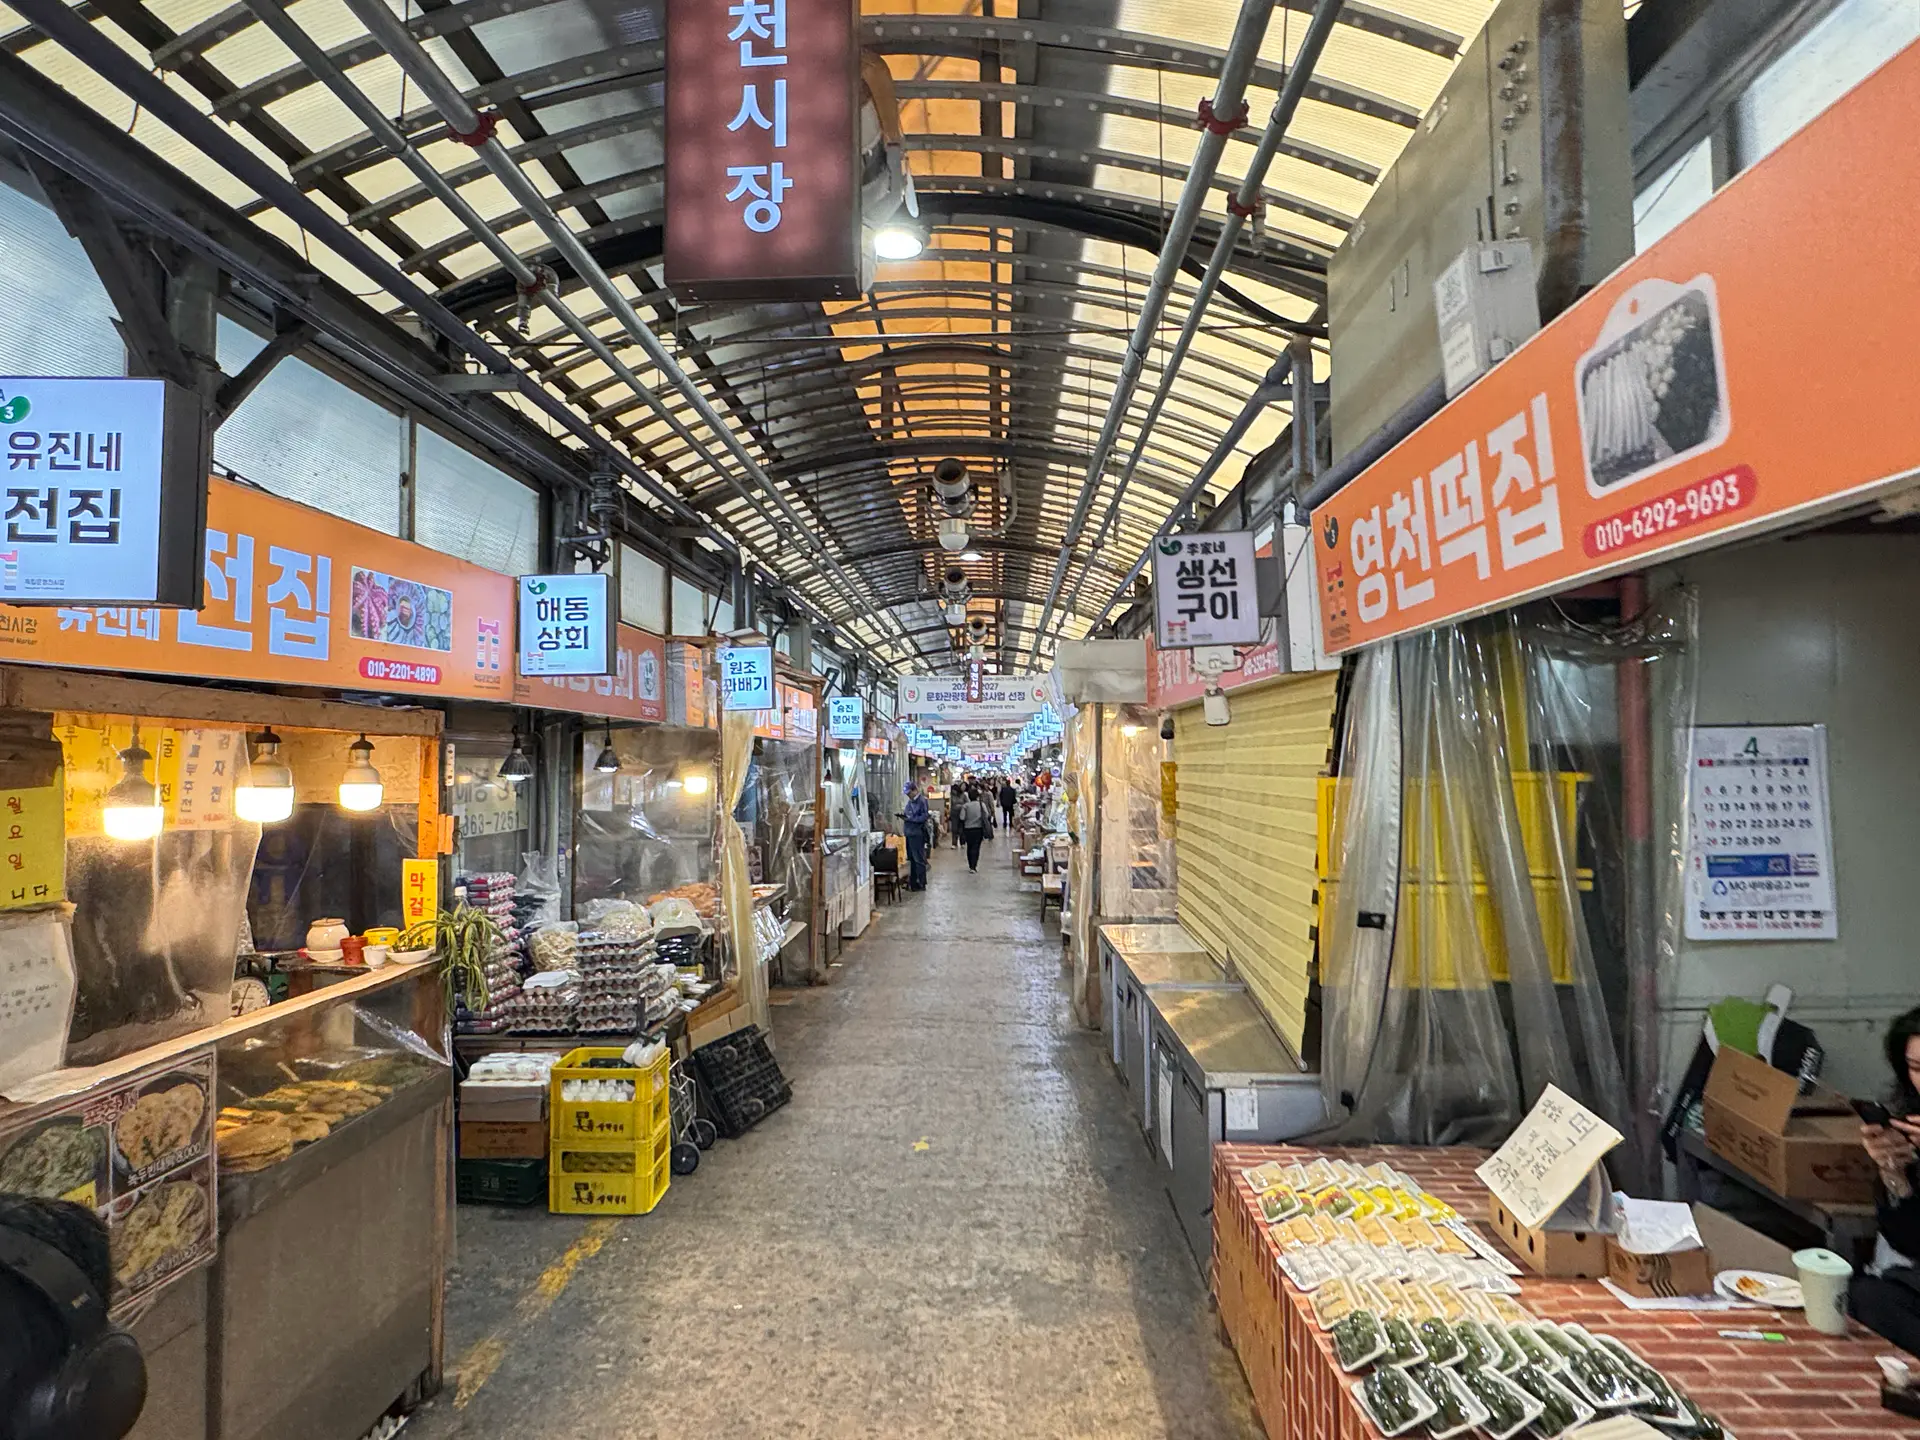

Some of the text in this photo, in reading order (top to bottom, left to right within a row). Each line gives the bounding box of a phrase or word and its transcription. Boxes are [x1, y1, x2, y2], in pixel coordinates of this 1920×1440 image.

[726, 0, 794, 233] 천시장
[4, 406, 15, 420] 3
[7, 431, 122, 472] 유진네
[4, 486, 121, 545] 전집
[1350, 391, 1563, 623] 영천떡집
[1594, 473, 1741, 553] 010-6292-9693
[1176, 557, 1238, 590] 생선
[536, 597, 589, 622] 해동
[1177, 590, 1239, 622] 구이
[537, 626, 589, 651] 상회
[367, 660, 437, 684] 010-2201-4890
[729, 661, 757, 675] 원조
[1008, 691, 1026, 701] 선정
[1743, 736, 1760, 758] 4
[1780, 784, 1793, 794] 10
[1797, 784, 1810, 795] 11
[1719, 802, 1730, 812] 13
[1734, 802, 1746, 811] 14
[6, 796, 24, 871] 월요일
[1720, 819, 1733, 829] 20
[1735, 819, 1747, 829] 21
[1750, 819, 1764, 829] 22
[1766, 819, 1780, 828] 23
[1781, 818, 1796, 828] 24
[1799, 818, 1813, 828] 25
[1720, 836, 1733, 846] 27
[1735, 836, 1749, 846] 28
[1751, 836, 1765, 846] 29
[1767, 836, 1781, 845] 30
[409, 871, 425, 932] 막걸
